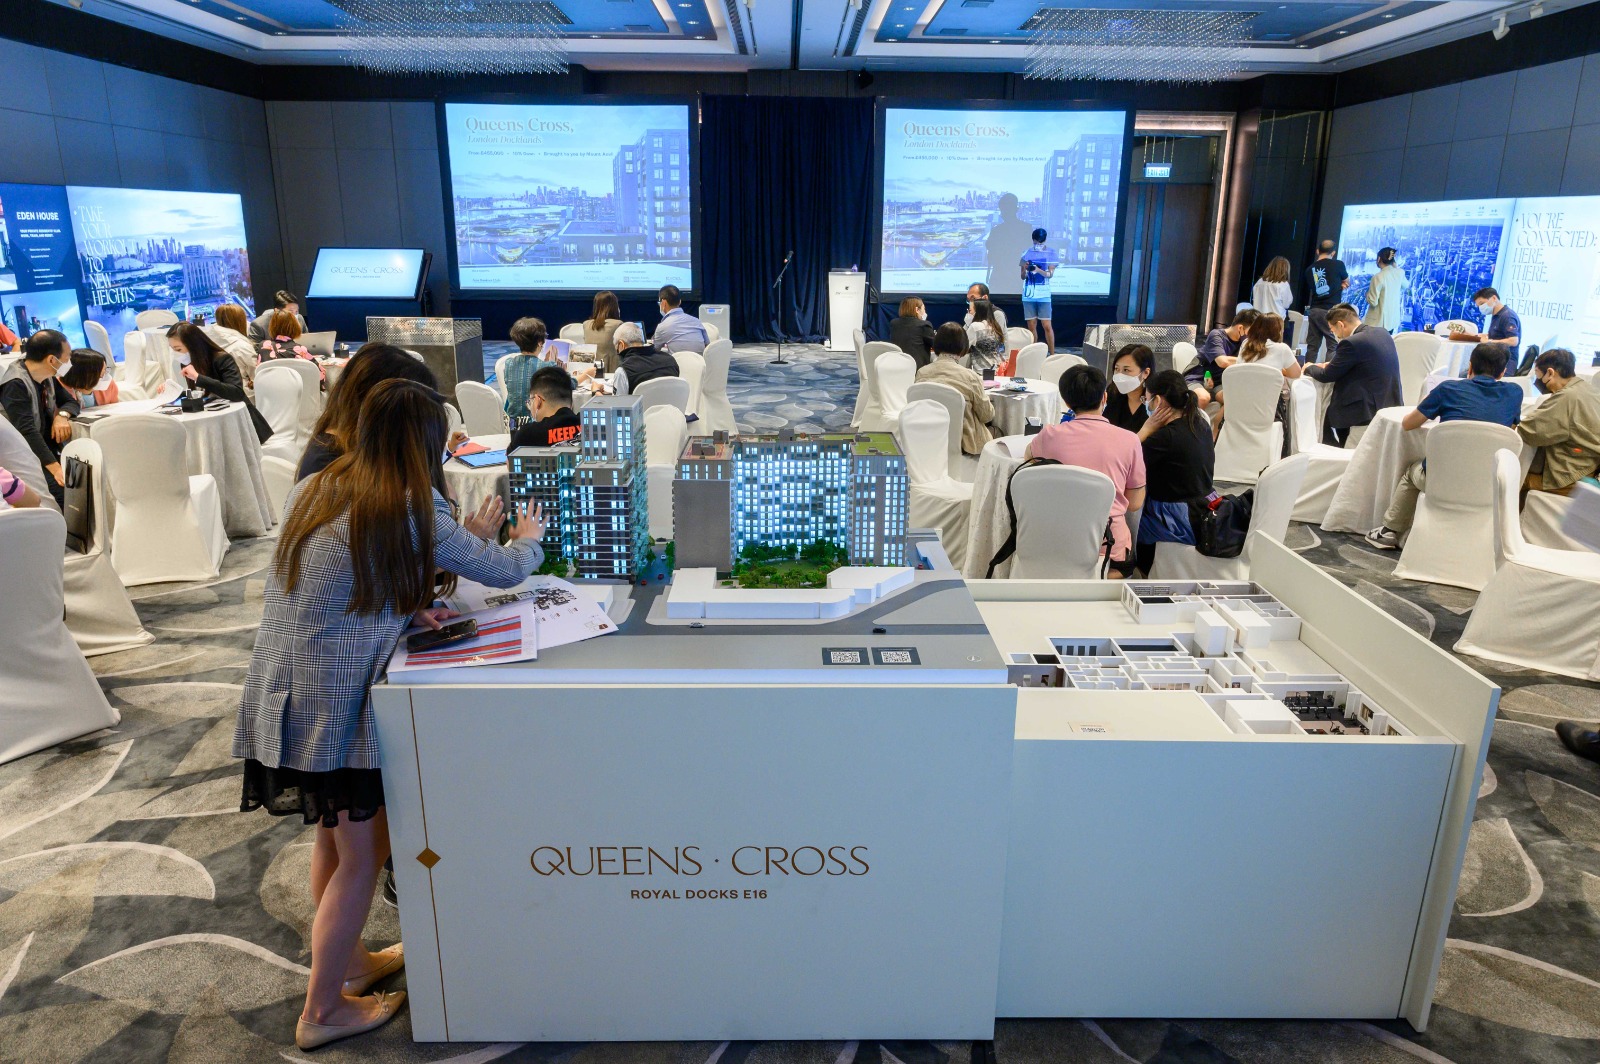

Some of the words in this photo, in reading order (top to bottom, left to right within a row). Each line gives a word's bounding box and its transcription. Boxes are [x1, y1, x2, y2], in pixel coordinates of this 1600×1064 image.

[465, 117, 524, 133] Queens
[528, 117, 574, 133] Cross,
[903, 122, 961, 138] Queens
[965, 122, 1010, 137] Cross,
[467, 135, 498, 143] London
[500, 135, 542, 144] Docklands
[903, 140, 934, 148] London
[936, 140, 977, 149] Docklands
[16, 211, 35, 220] EDEN
[36, 211, 59, 220] HOUSE
[78, 205, 105, 222] TAKE
[1522, 212, 1565, 229] YOU'RE
[81, 223, 112, 239] YOUR
[1517, 230, 1598, 248] CONNECTED:
[84, 238, 136, 256] WORKOUT
[86, 256, 104, 273] TO
[1513, 247, 1545, 265] HERE,
[330, 266, 368, 274] QUEENS
[373, 266, 404, 274] CROSS
[1511, 264, 1548, 283] THERE,
[89, 272, 112, 289] NEW
[92, 287, 136, 306] HEIGHTS
[1507, 282, 1531, 298] AND
[548, 425, 576, 444] KEEP
[530, 846, 703, 876] QUEENS
[731, 846, 870, 876] CROSS
[630, 889, 681, 900] ROYAL
[685, 889, 739, 900] DOCKS
[743, 889, 768, 900] E16
